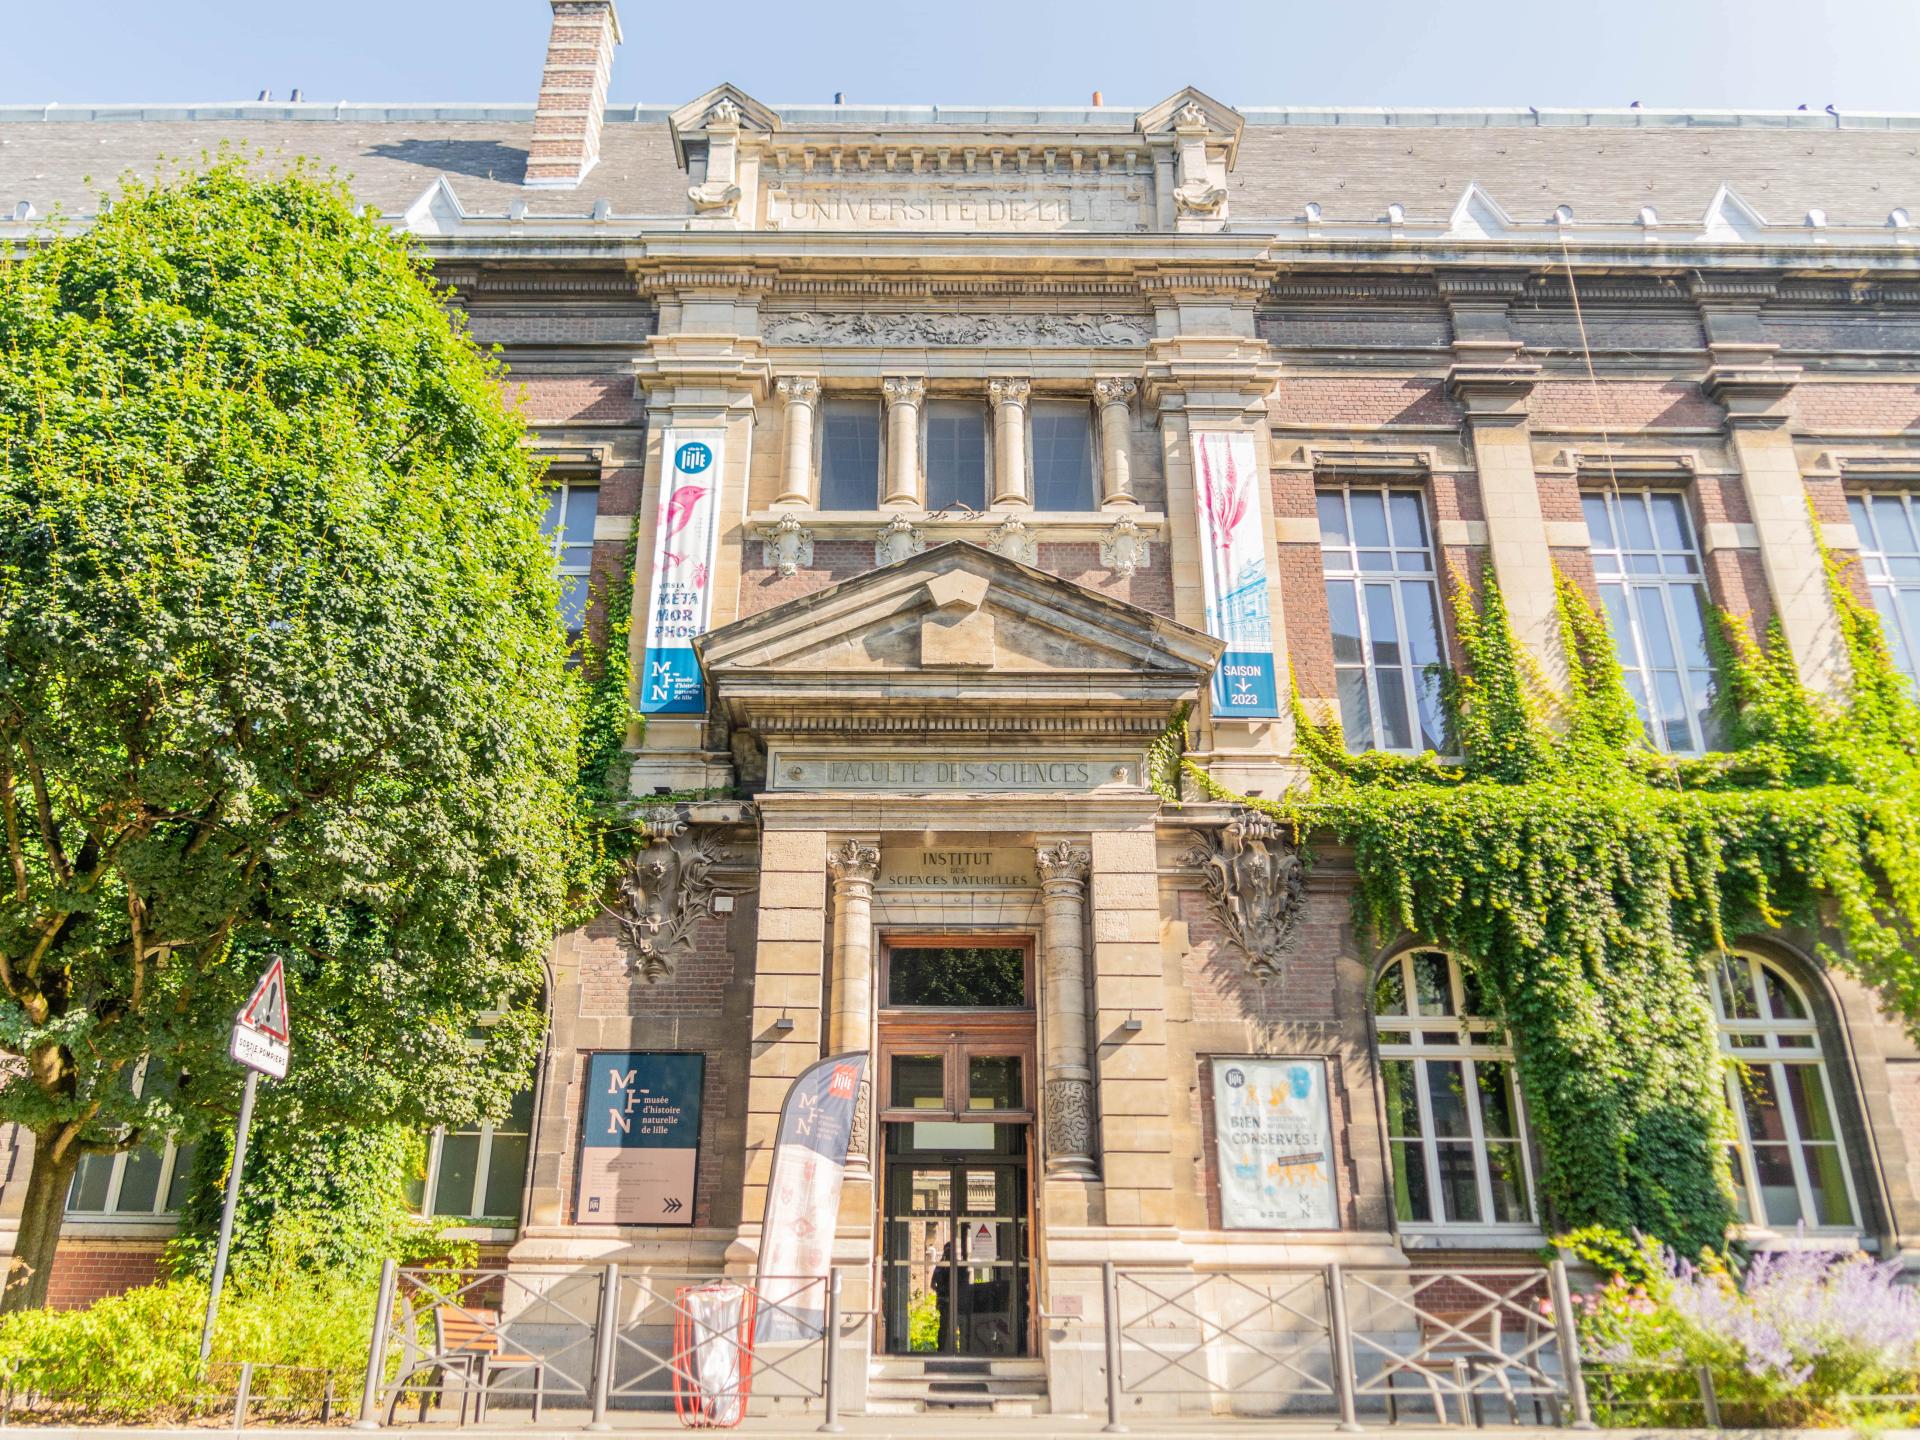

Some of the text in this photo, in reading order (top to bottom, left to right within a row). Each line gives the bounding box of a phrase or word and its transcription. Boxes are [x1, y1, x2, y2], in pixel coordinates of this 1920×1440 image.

[988, 199, 1026, 221] DE
[1037, 199, 1126, 221] LILLE
[656, 609, 693, 621] MOR
[1224, 666, 1261, 676] SAISON
[1231, 694, 1258, 705] 2023
[937, 763, 975, 783] DES
[985, 763, 1089, 783] SCIENCES
[923, 852, 993, 865] INSTITUT
[889, 875, 1028, 885] SCIENCES NATURELLES
[643, 1095, 670, 1104] musée
[642, 1105, 681, 1114] d'histoire
[641, 1115, 679, 1124] naturelle
[1230, 1115, 1261, 1129] BIEN
[641, 1125, 669, 1134] de lille
